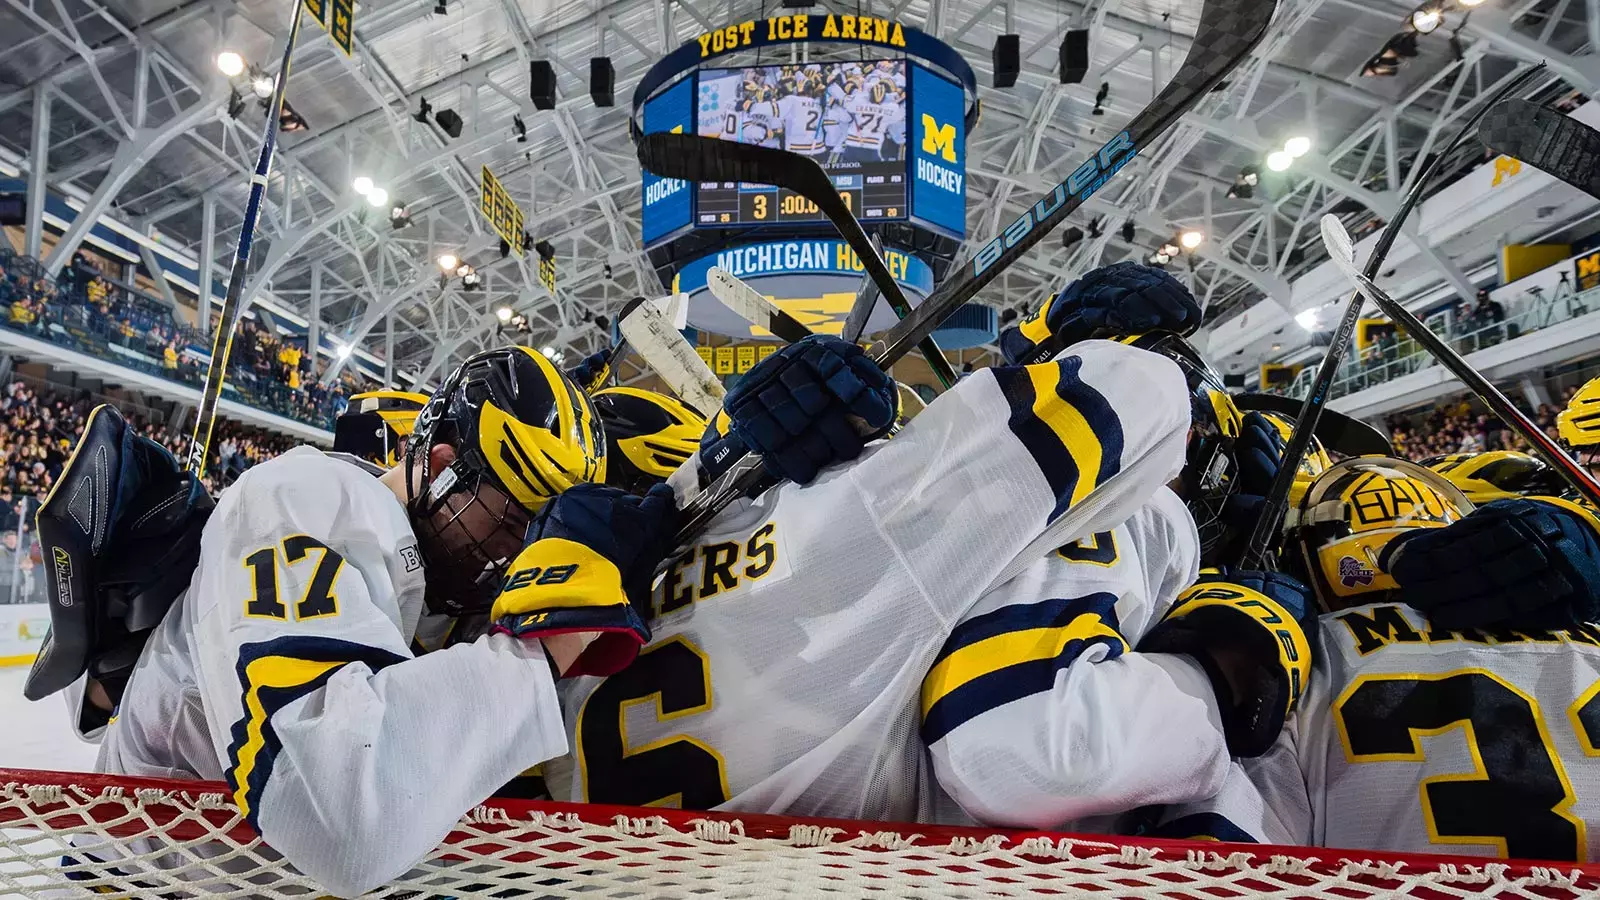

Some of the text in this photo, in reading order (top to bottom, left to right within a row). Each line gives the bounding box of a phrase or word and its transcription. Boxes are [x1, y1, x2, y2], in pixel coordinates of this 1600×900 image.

[698, 13, 906, 57] YOST ICE ARENA
[806, 111, 819, 131] 2
[860, 113, 883, 133] 71
[922, 113, 957, 164] M
[918, 157, 962, 195] HOCKEY
[753, 194, 767, 219] 3
[974, 131, 1134, 277] BAUER
[717, 242, 909, 281] MICHIGAN HOEY
[714, 446, 730, 463] HAIL
[243, 533, 340, 622] 17
[652, 521, 777, 618] ERS
[575, 633, 732, 809] 6
[1331, 667, 1600, 864] 3
